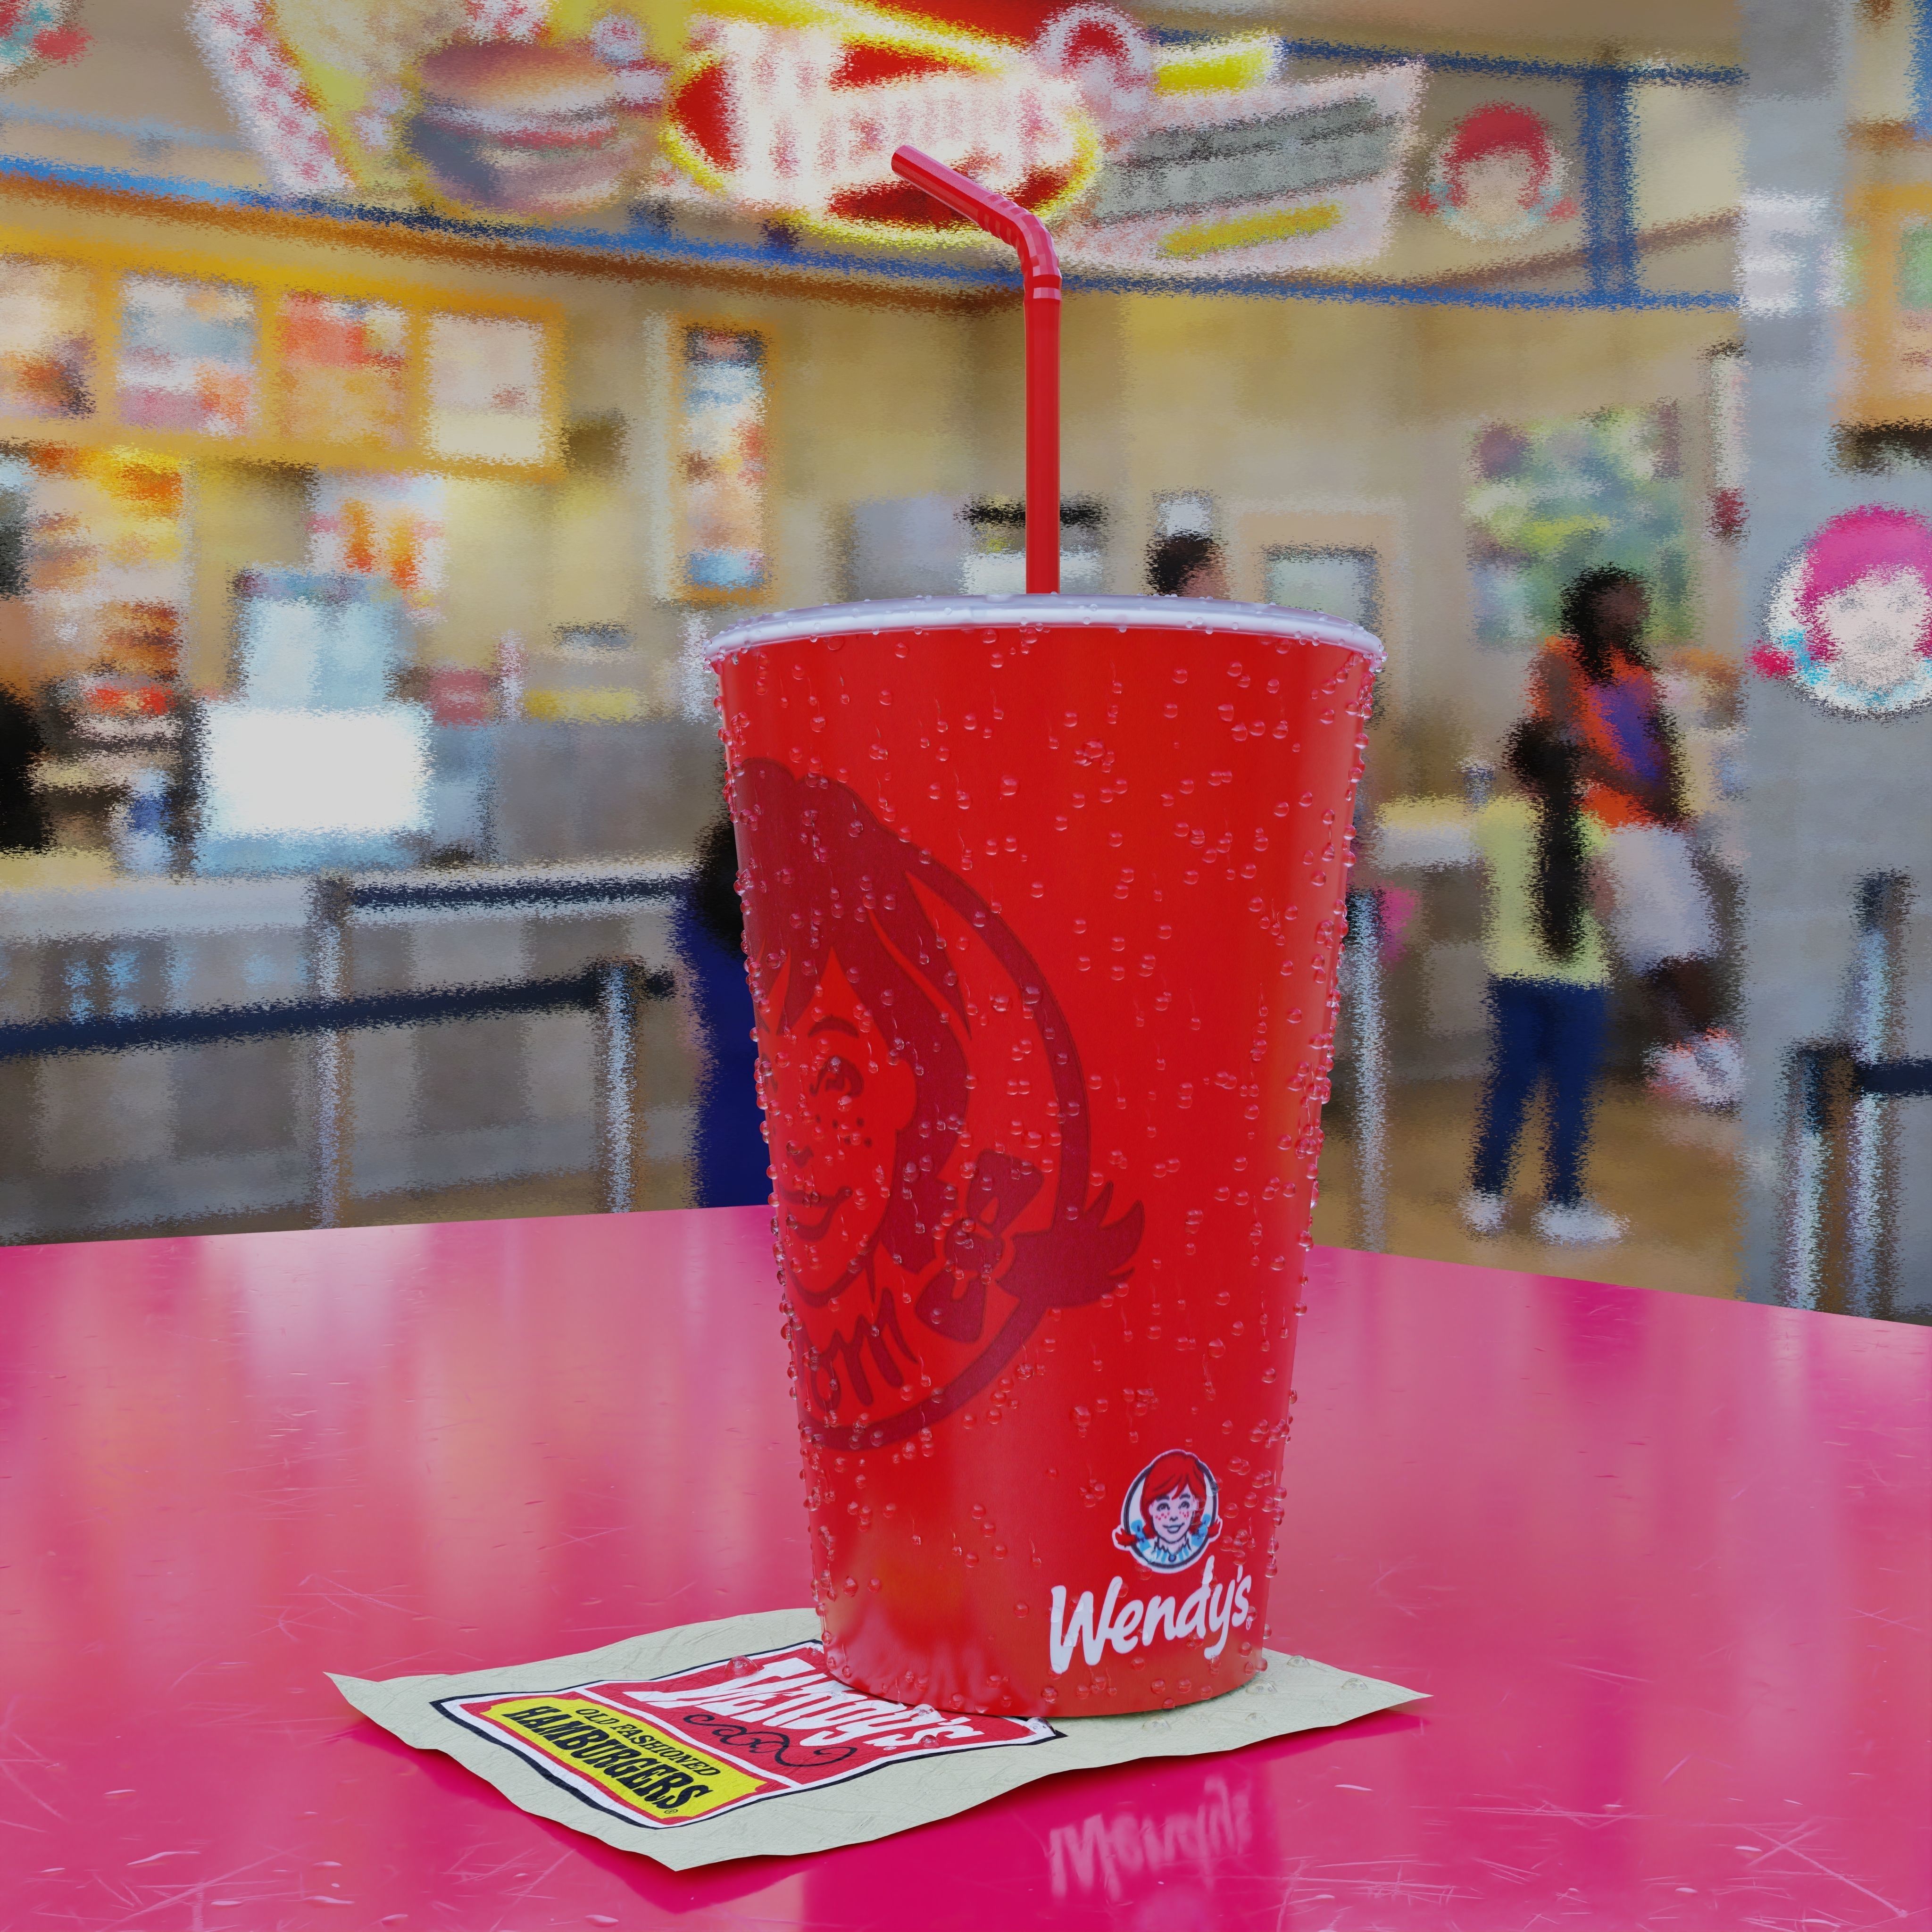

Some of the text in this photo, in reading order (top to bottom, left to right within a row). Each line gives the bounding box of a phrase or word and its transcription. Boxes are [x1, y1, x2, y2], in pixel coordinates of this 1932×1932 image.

[1050, 1555, 1251, 1674] Wendy's
[501, 1706, 713, 1809] HAMBURGERS
[575, 1708, 721, 1776] OLD FASHIONED
